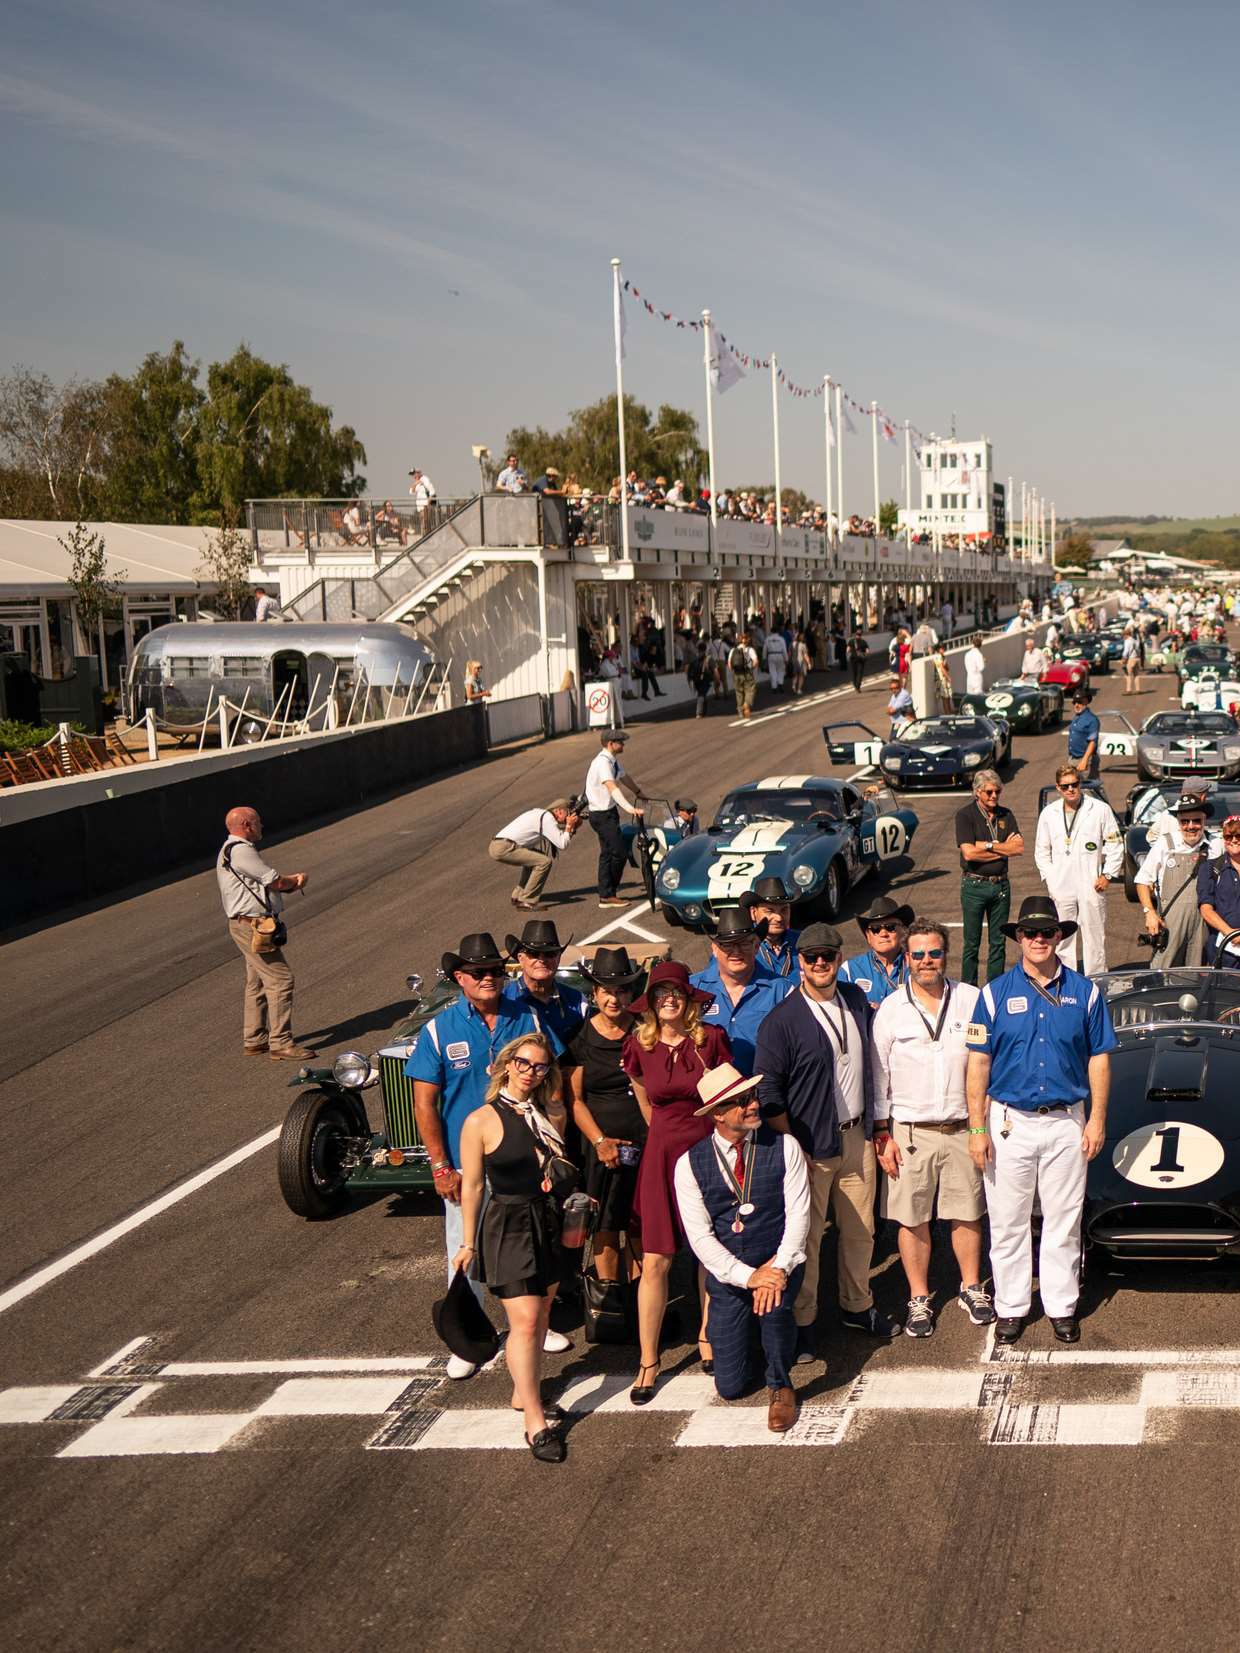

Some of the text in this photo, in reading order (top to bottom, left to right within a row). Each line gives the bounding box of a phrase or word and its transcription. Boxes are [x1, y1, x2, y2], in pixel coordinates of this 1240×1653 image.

[863, 745, 873, 765] 1
[1106, 743, 1126, 756] 23
[864, 838, 874, 853] GT
[881, 824, 900, 855] 12
[719, 861, 755, 877] 12
[1149, 1126, 1185, 1172] 1
